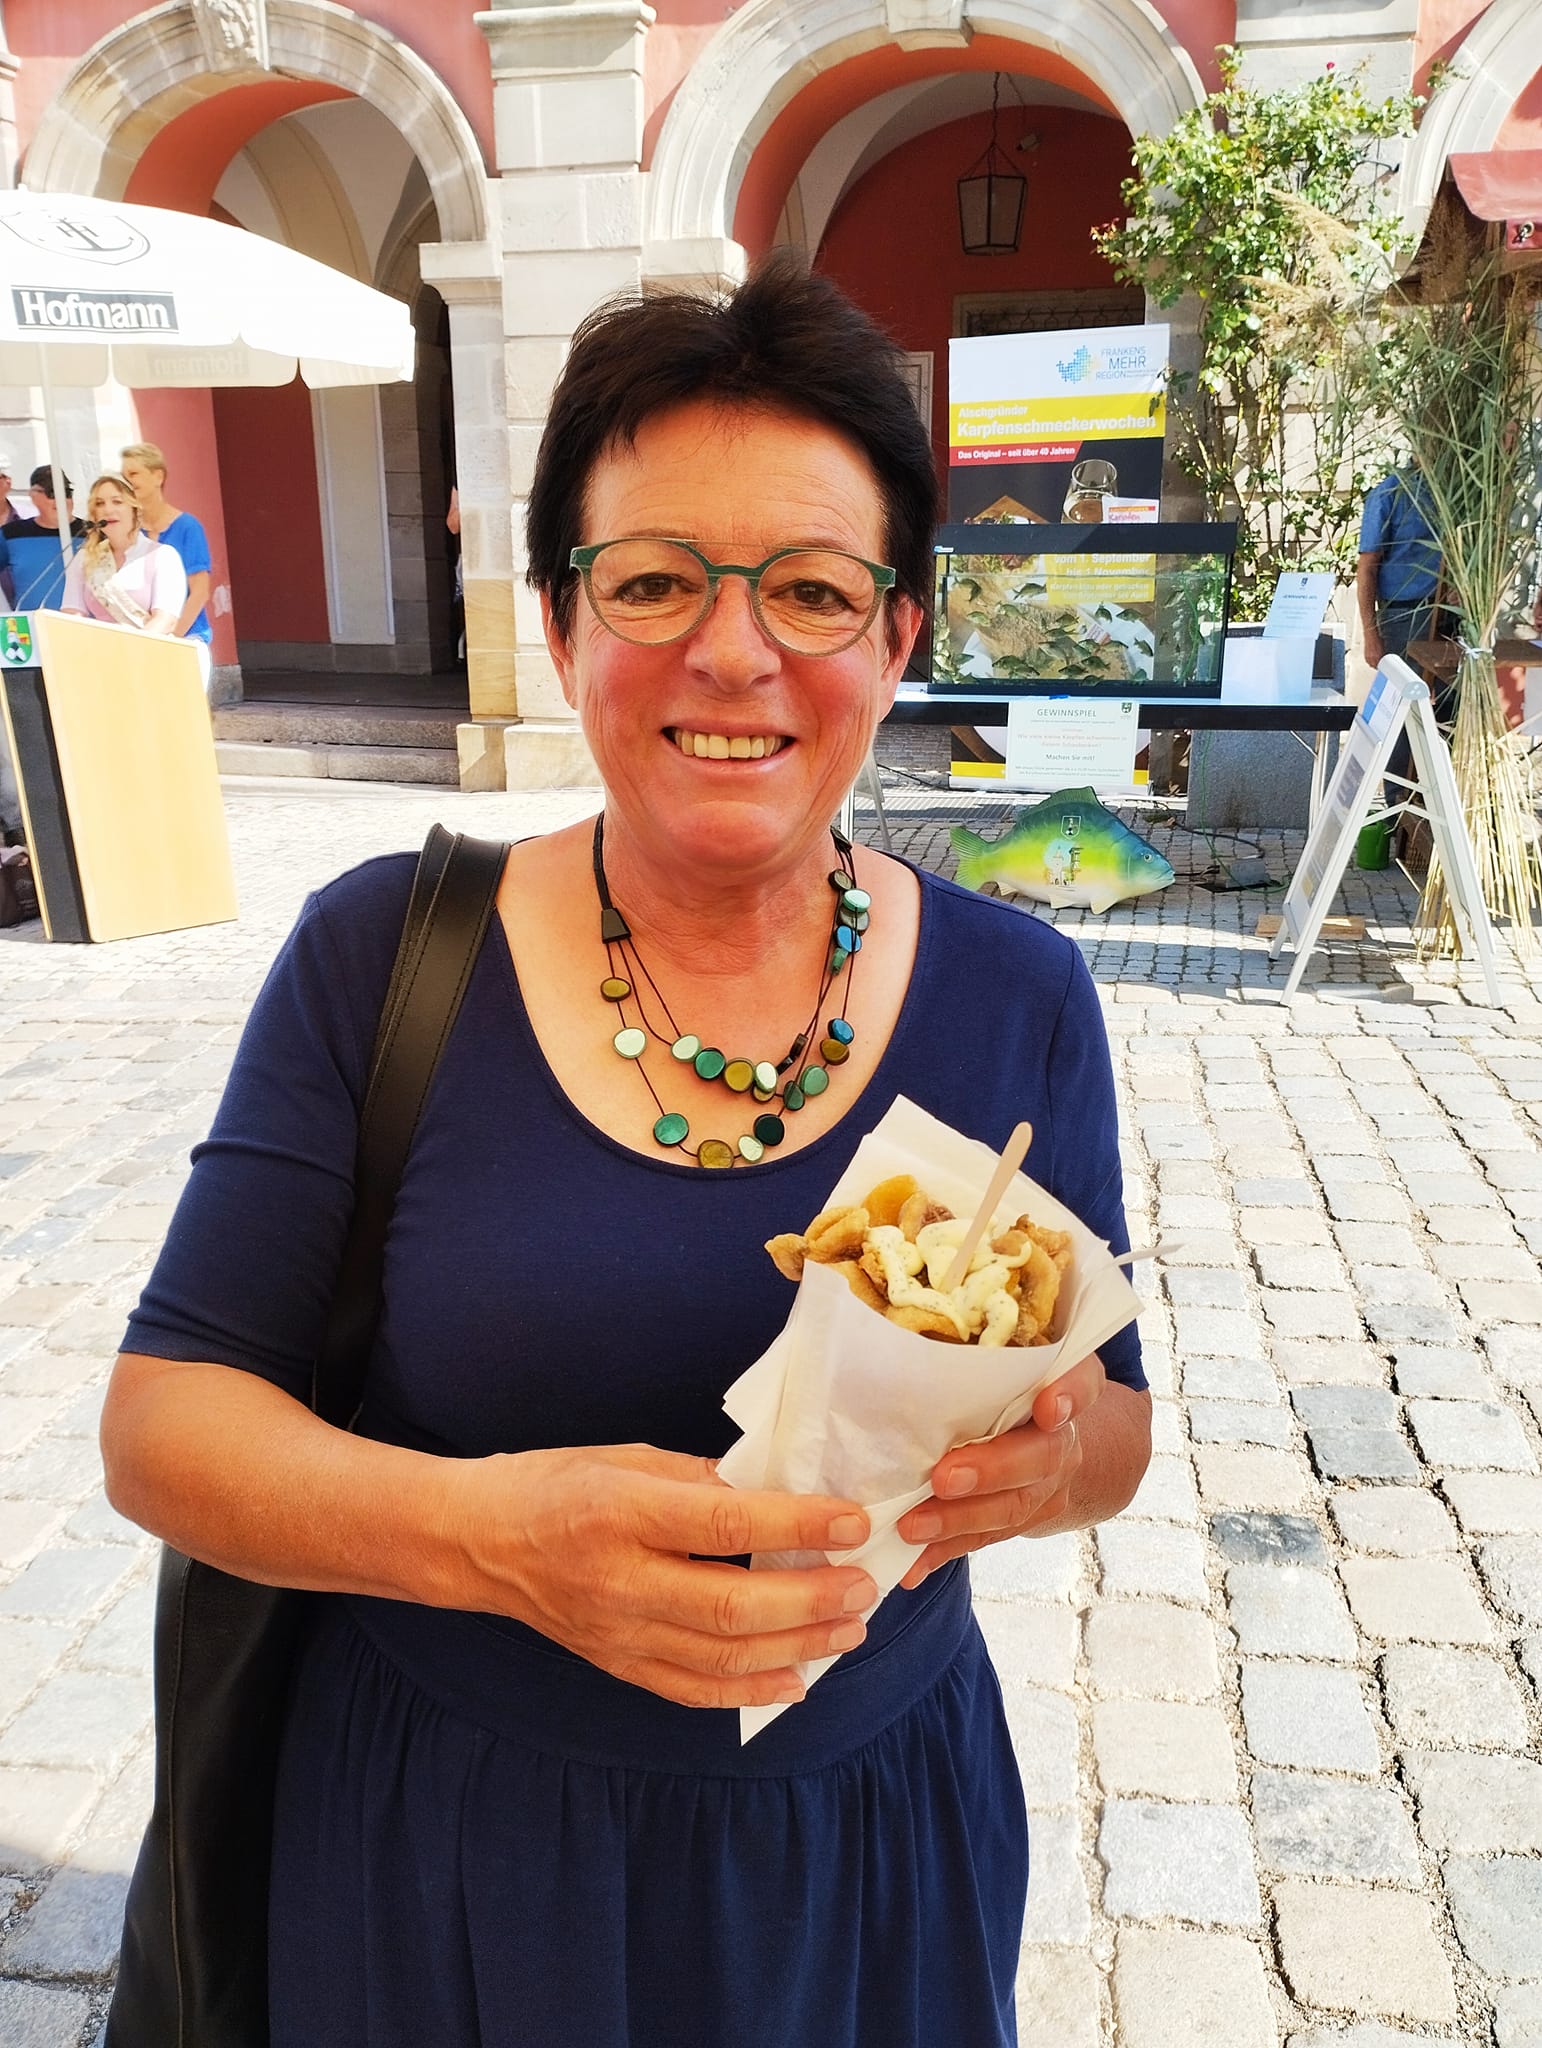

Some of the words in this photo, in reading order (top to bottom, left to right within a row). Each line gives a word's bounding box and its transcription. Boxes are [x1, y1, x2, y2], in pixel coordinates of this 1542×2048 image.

[19, 291, 171, 329] Hofmann
[1101, 346, 1146, 357] FRANKENS
[1109, 355, 1146, 369] MEHR
[1096, 370, 1126, 380] REGION
[957, 415, 1156, 438] Karpfenschmeckerwochen
[958, 451, 972, 460] Das
[973, 449, 1001, 460] Original
[1008, 449, 1021, 457] seit
[1022, 448, 1038, 457] über
[1050, 447, 1075, 456] Jahren
[1092, 554, 1149, 566] September
[1037, 708, 1097, 718] GEWINNSPIEL
